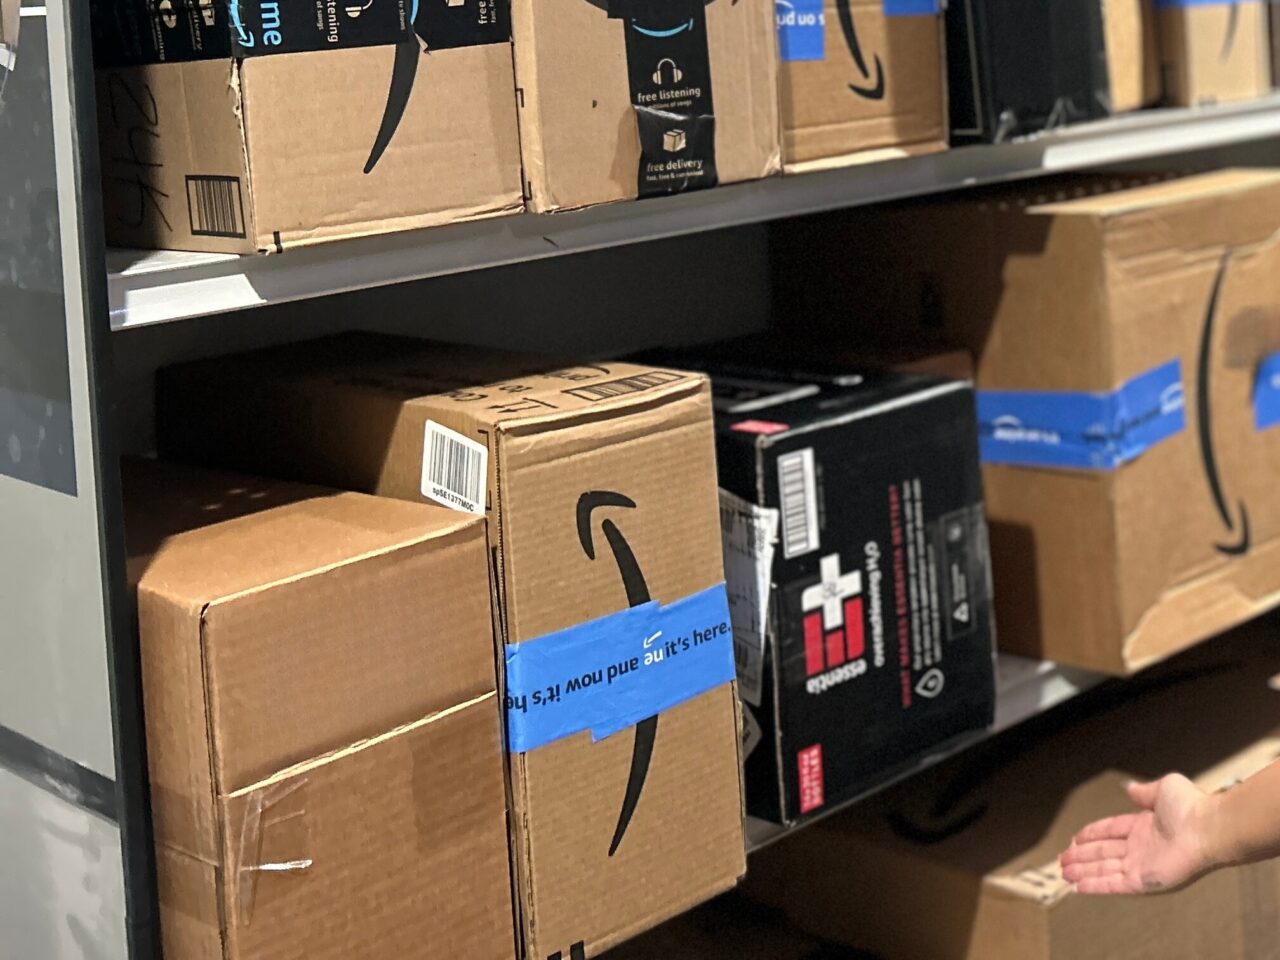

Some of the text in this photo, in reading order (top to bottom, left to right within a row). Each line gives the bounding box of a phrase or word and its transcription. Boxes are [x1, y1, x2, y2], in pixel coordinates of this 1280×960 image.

[477, 3, 488, 25] free
[794, 14, 814, 26] on
[637, 87, 701, 102] free listening
[647, 159, 703, 172] free delivery
[666, 622, 732, 658] it's here.
[606, 656, 639, 684] and
[806, 659, 867, 694] essentia
[565, 670, 603, 694] now
[532, 684, 561, 707] it's
